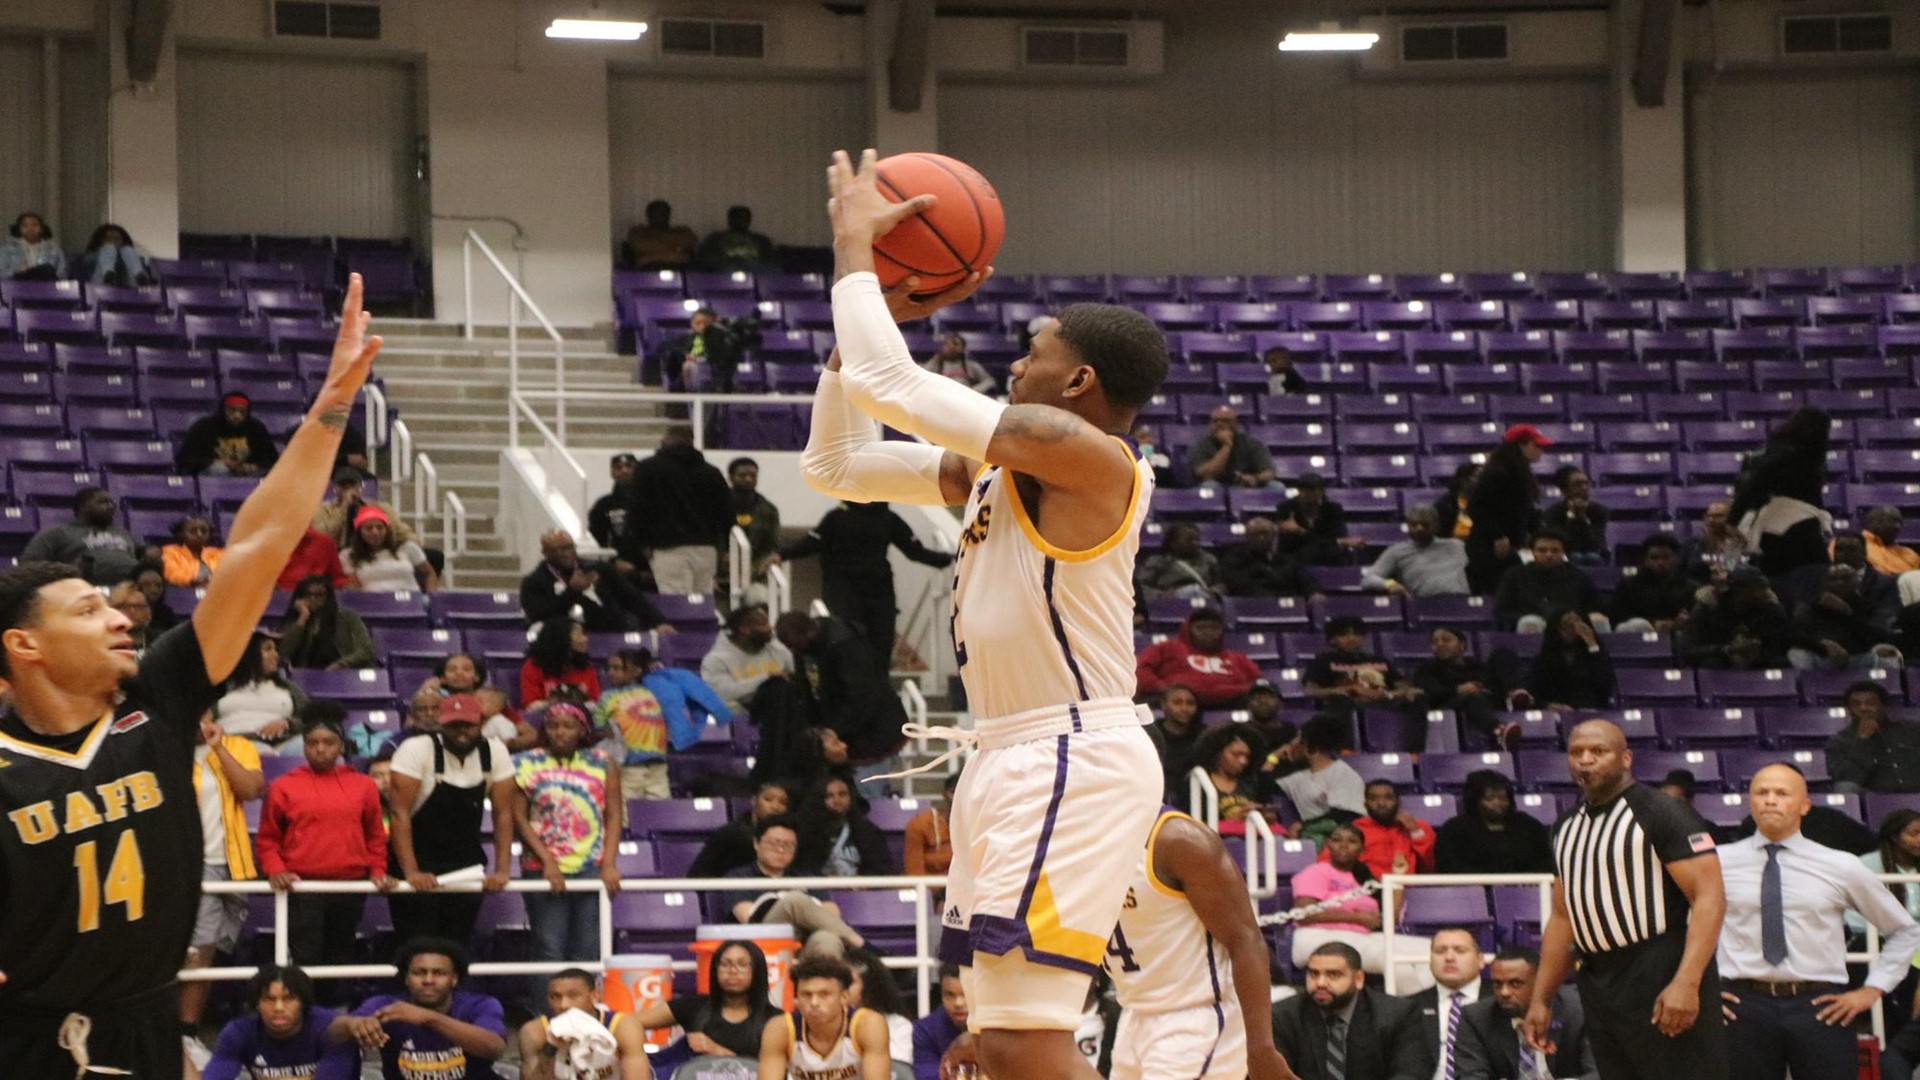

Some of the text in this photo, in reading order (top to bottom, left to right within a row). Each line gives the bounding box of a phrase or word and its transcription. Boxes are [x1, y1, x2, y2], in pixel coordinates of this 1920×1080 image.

[74, 829, 144, 932] 14
[1103, 919, 1140, 973] 4
[639, 975, 661, 999] G
[1078, 1036, 1096, 1056] G
